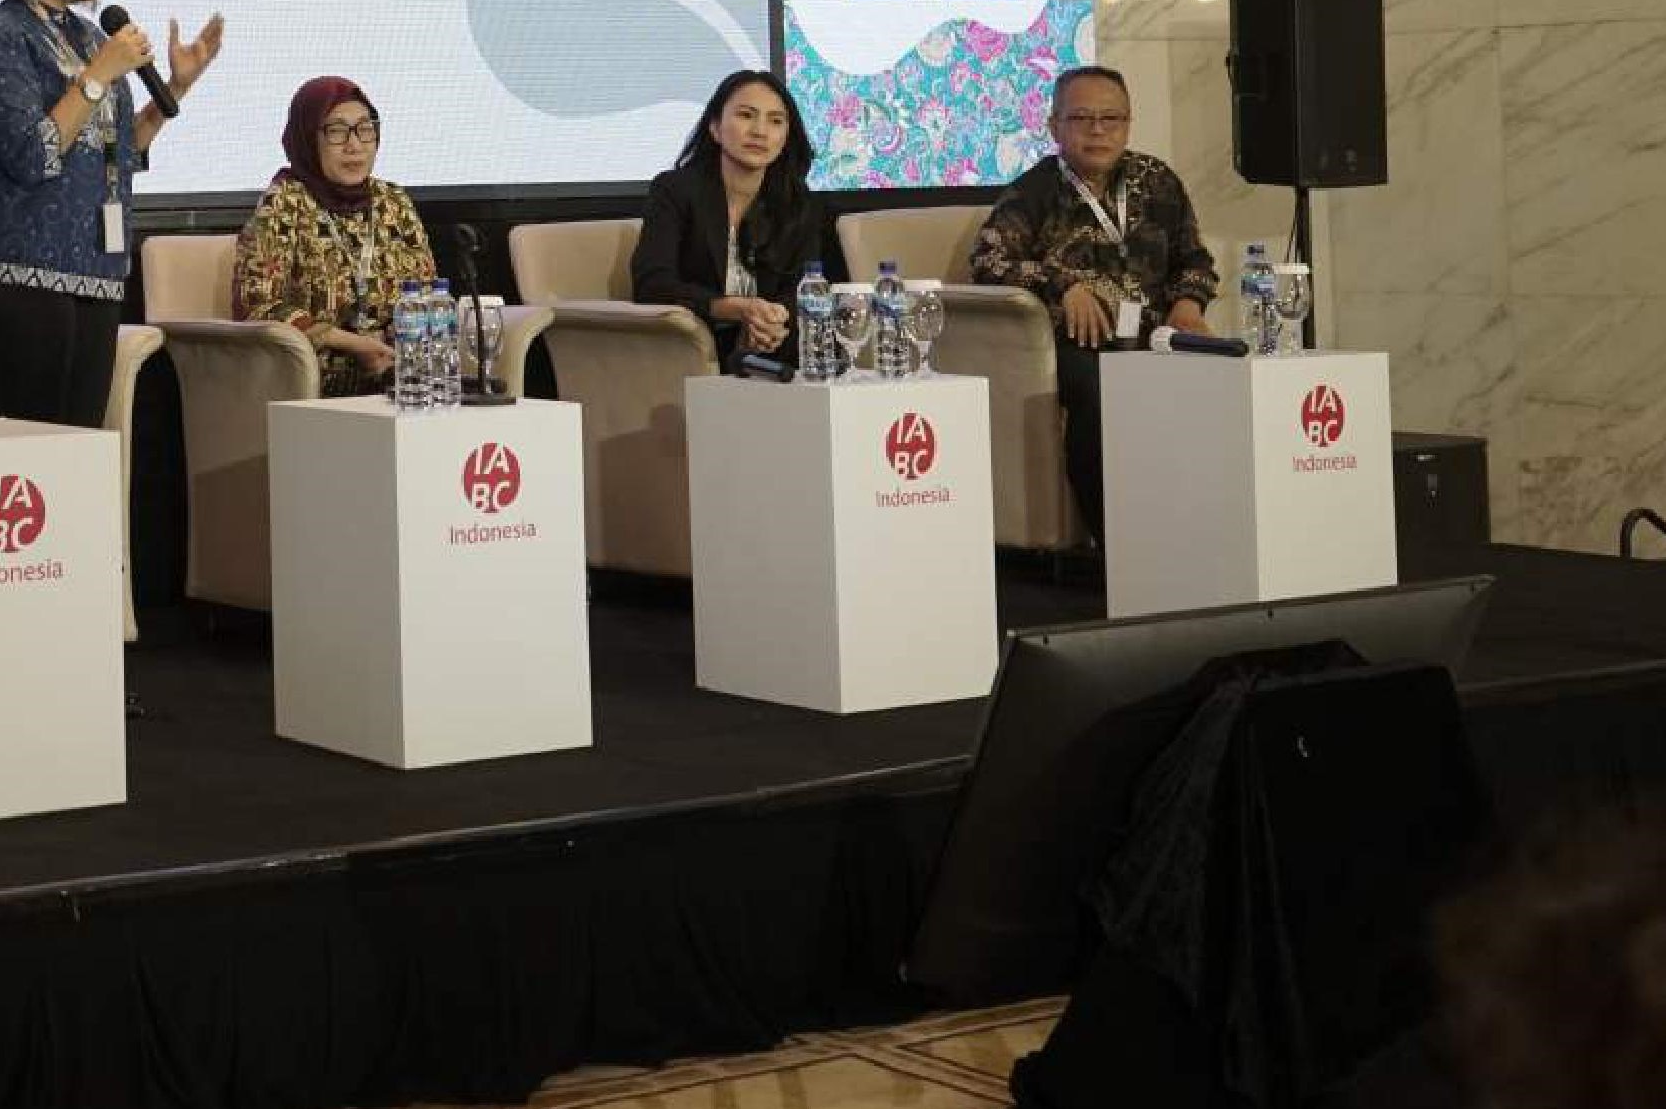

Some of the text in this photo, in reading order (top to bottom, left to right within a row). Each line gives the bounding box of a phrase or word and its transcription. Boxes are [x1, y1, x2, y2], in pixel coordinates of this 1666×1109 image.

[1292, 453, 1358, 473] Indonesia
[875, 486, 950, 508] Indonesia
[450, 520, 537, 545] Indonesia
